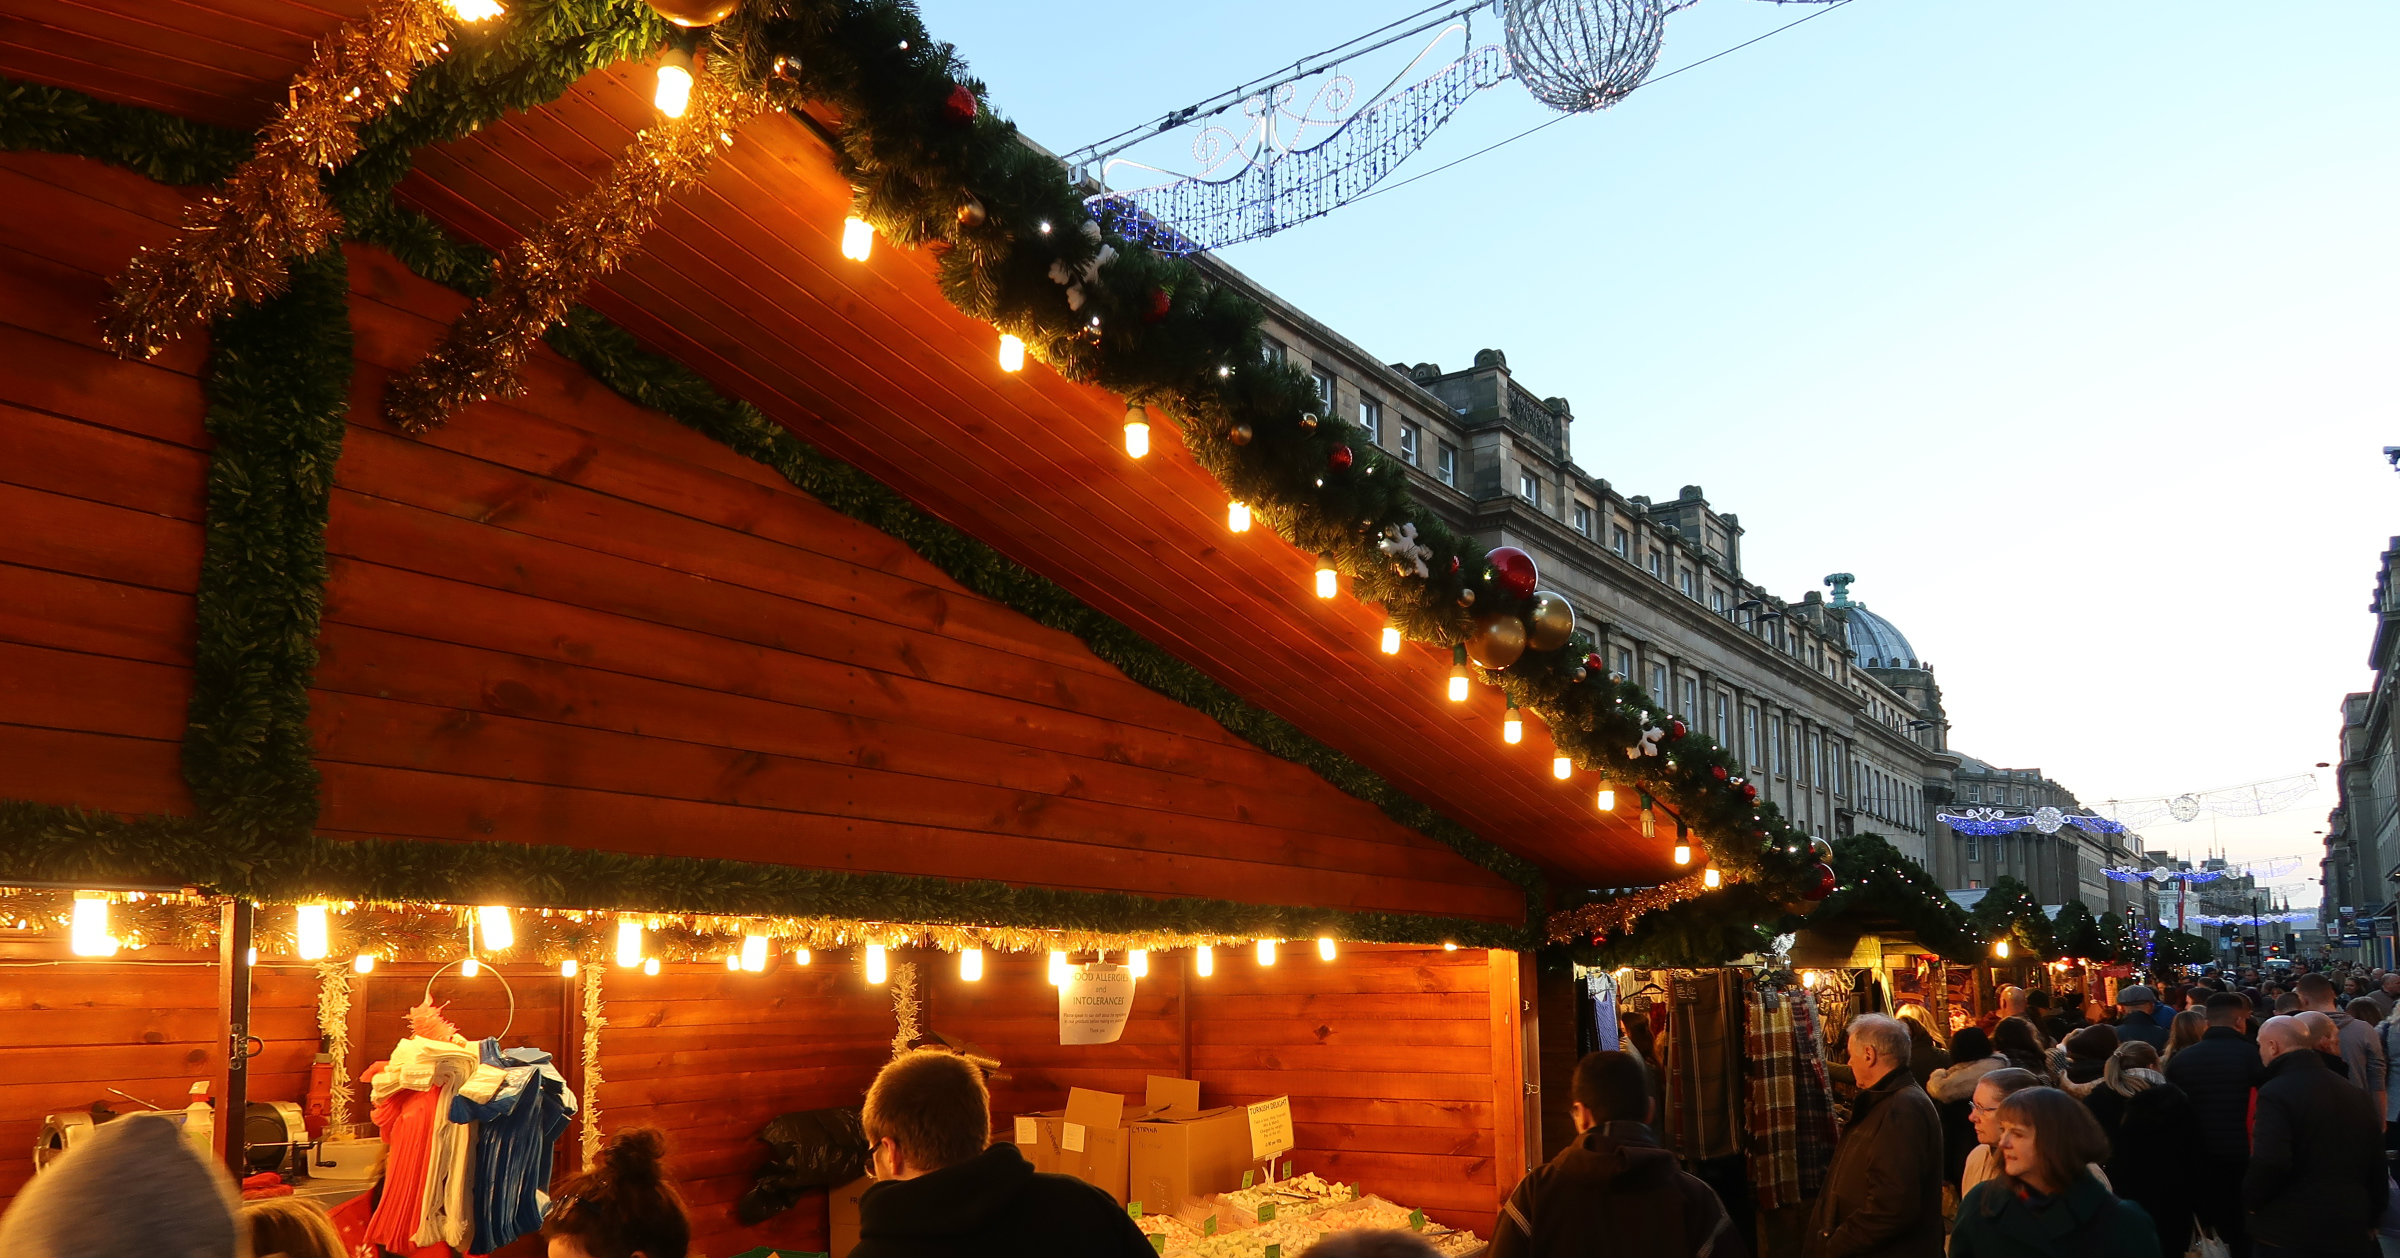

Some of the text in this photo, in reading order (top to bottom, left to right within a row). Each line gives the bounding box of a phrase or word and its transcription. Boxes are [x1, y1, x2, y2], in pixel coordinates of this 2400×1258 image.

[1072, 973, 1094, 982] OOD
[1096, 985, 1107, 993] and
[1073, 996, 1124, 1006] INTOLERANCES
[1249, 1098, 1287, 1115] TURKISH DELIGHT
